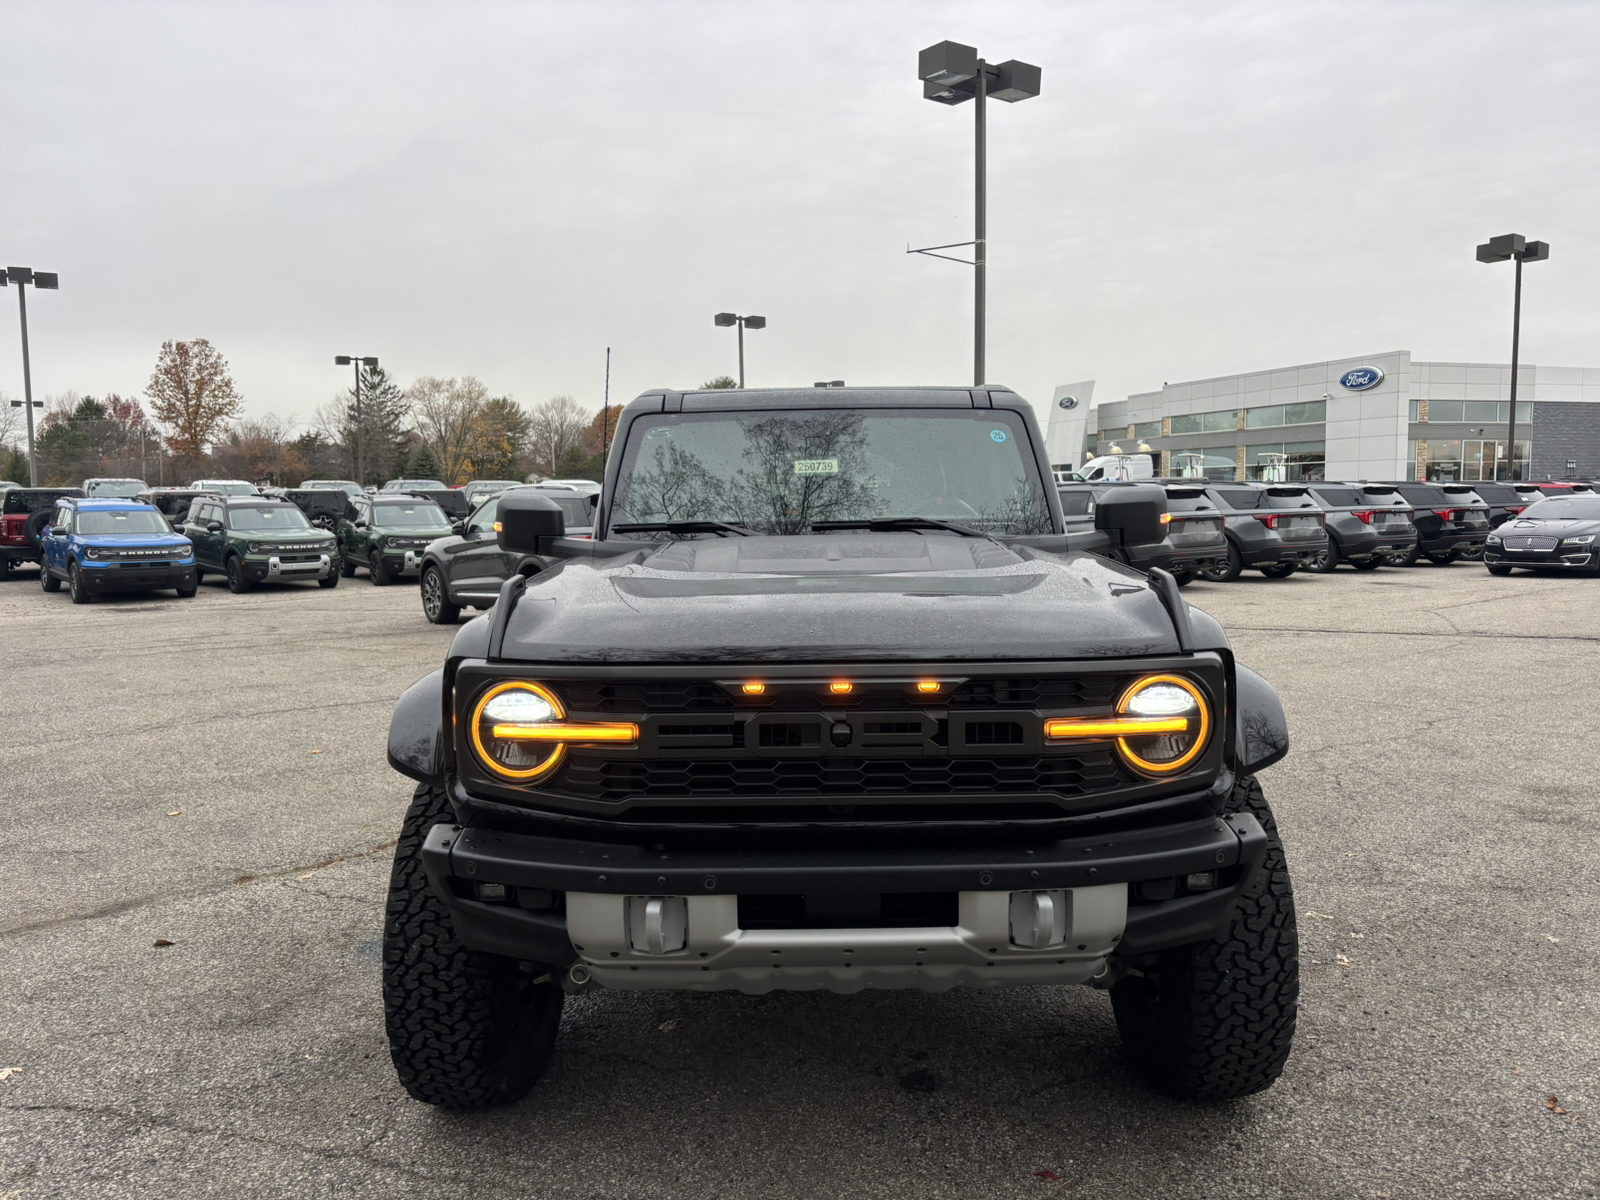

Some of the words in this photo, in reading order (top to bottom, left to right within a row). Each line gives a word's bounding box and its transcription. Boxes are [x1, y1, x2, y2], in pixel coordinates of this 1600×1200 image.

[1346, 371, 1370, 387] Ford
[798, 461, 833, 471] 250739
[641, 712, 1042, 757] FORD
